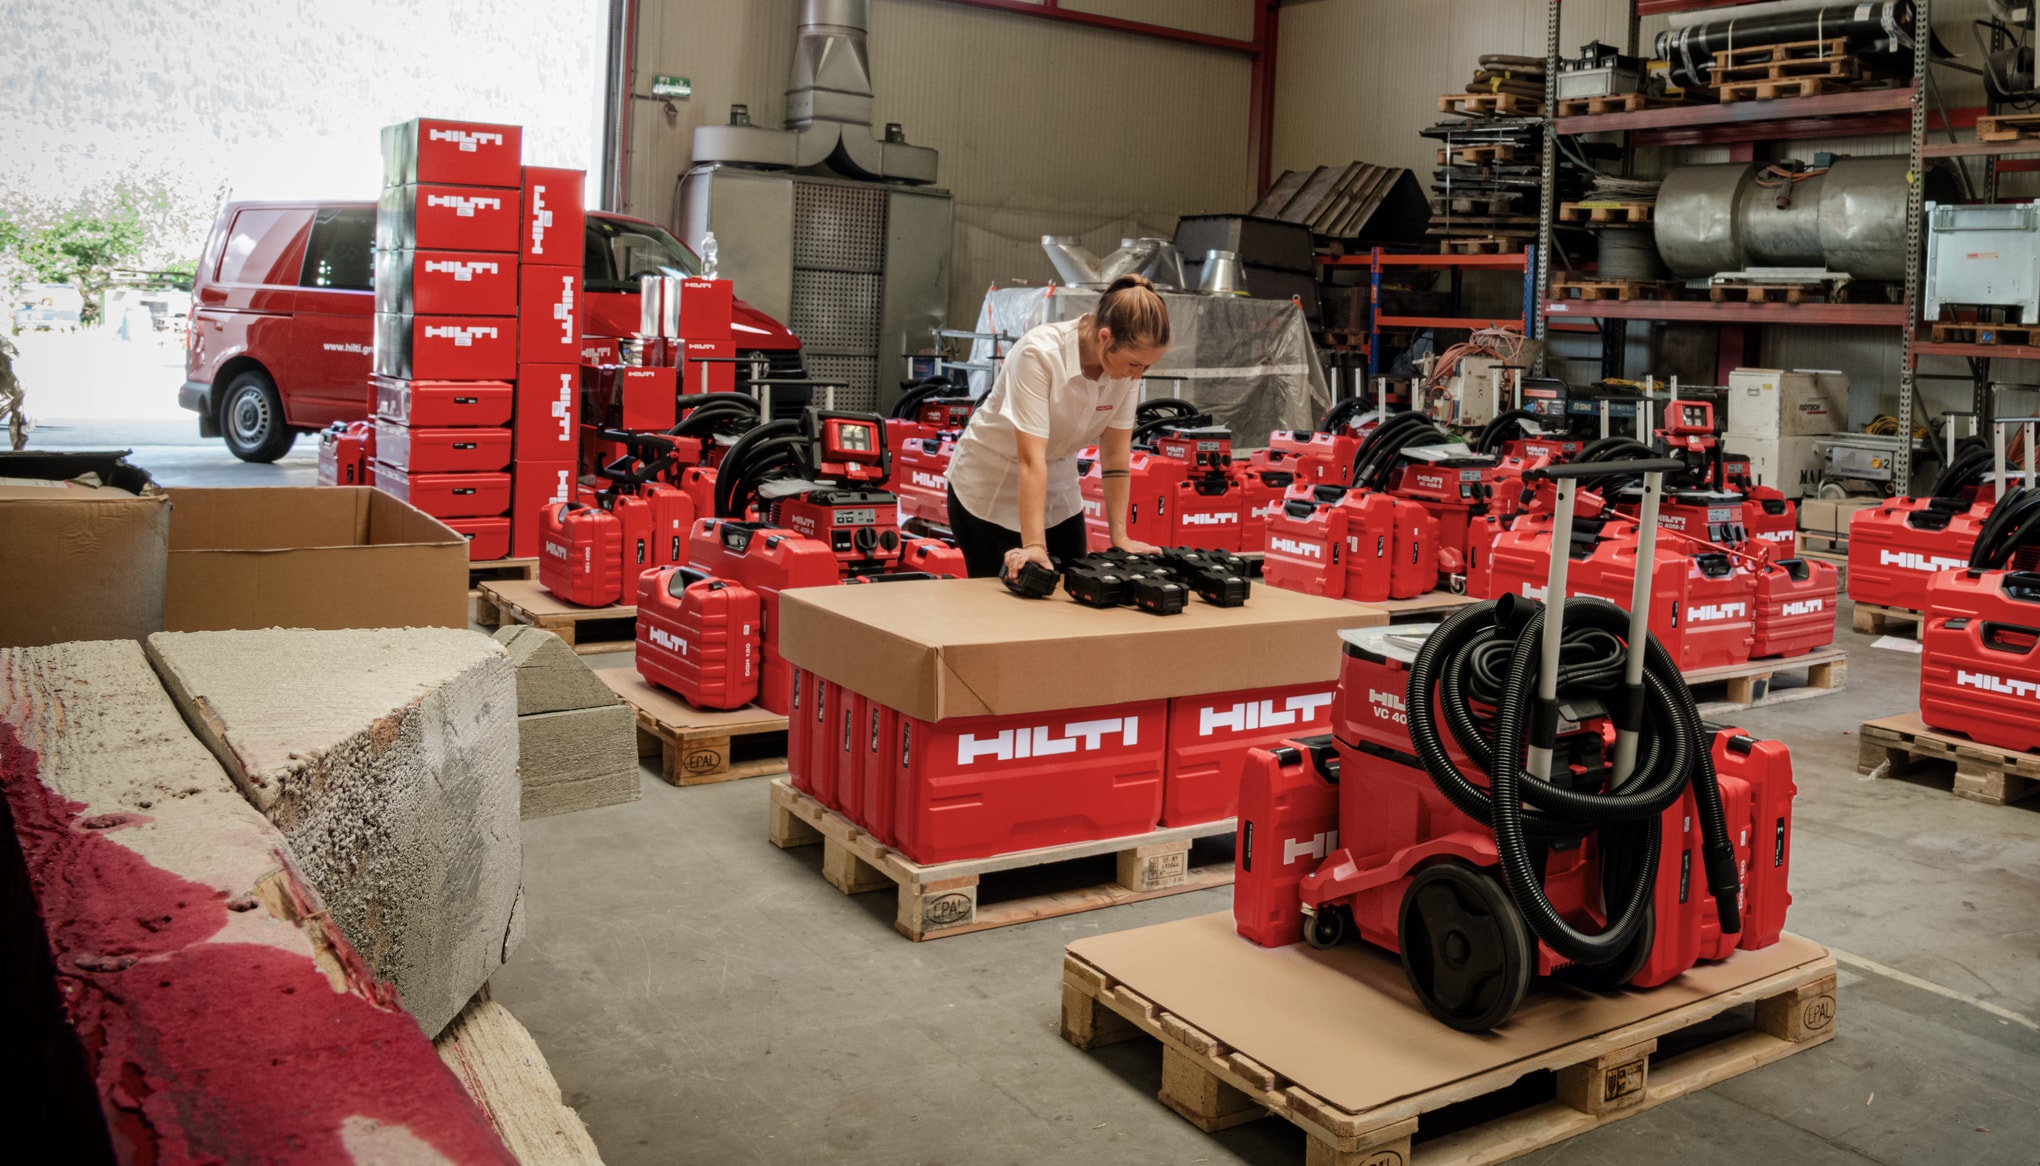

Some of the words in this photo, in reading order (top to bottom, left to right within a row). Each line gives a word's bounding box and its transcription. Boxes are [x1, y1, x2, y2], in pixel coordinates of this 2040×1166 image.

[430, 129, 502, 145] HILTI
[428, 195, 500, 210] HILTI
[531, 185, 545, 254] HILTI
[425, 260, 498, 274] HILTI
[561, 276, 574, 344] HILTI
[425, 326, 497, 339] HILTI
[559, 373, 572, 441] HILTI
[1883, 459, 1890, 470] 2
[1417, 474, 1443, 485] HILTI
[791, 514, 815, 529] HILTI
[1182, 512, 1238, 525] HILTI
[1664, 523, 1685, 531] 40M-X
[545, 540, 567, 560] HILTI
[1271, 537, 1321, 558] HILTI
[1687, 602, 1745, 622] HILTI
[1782, 599, 1822, 617] HILTI
[649, 626, 687, 656] HILTI
[1369, 688, 1406, 712] HIL
[1199, 691, 1336, 736] HILT
[1373, 706, 1390, 720] VC
[957, 716, 1139, 765] HILTI
[690, 754, 716, 769] EPAL
[1807, 1001, 1831, 1025] EPAL
